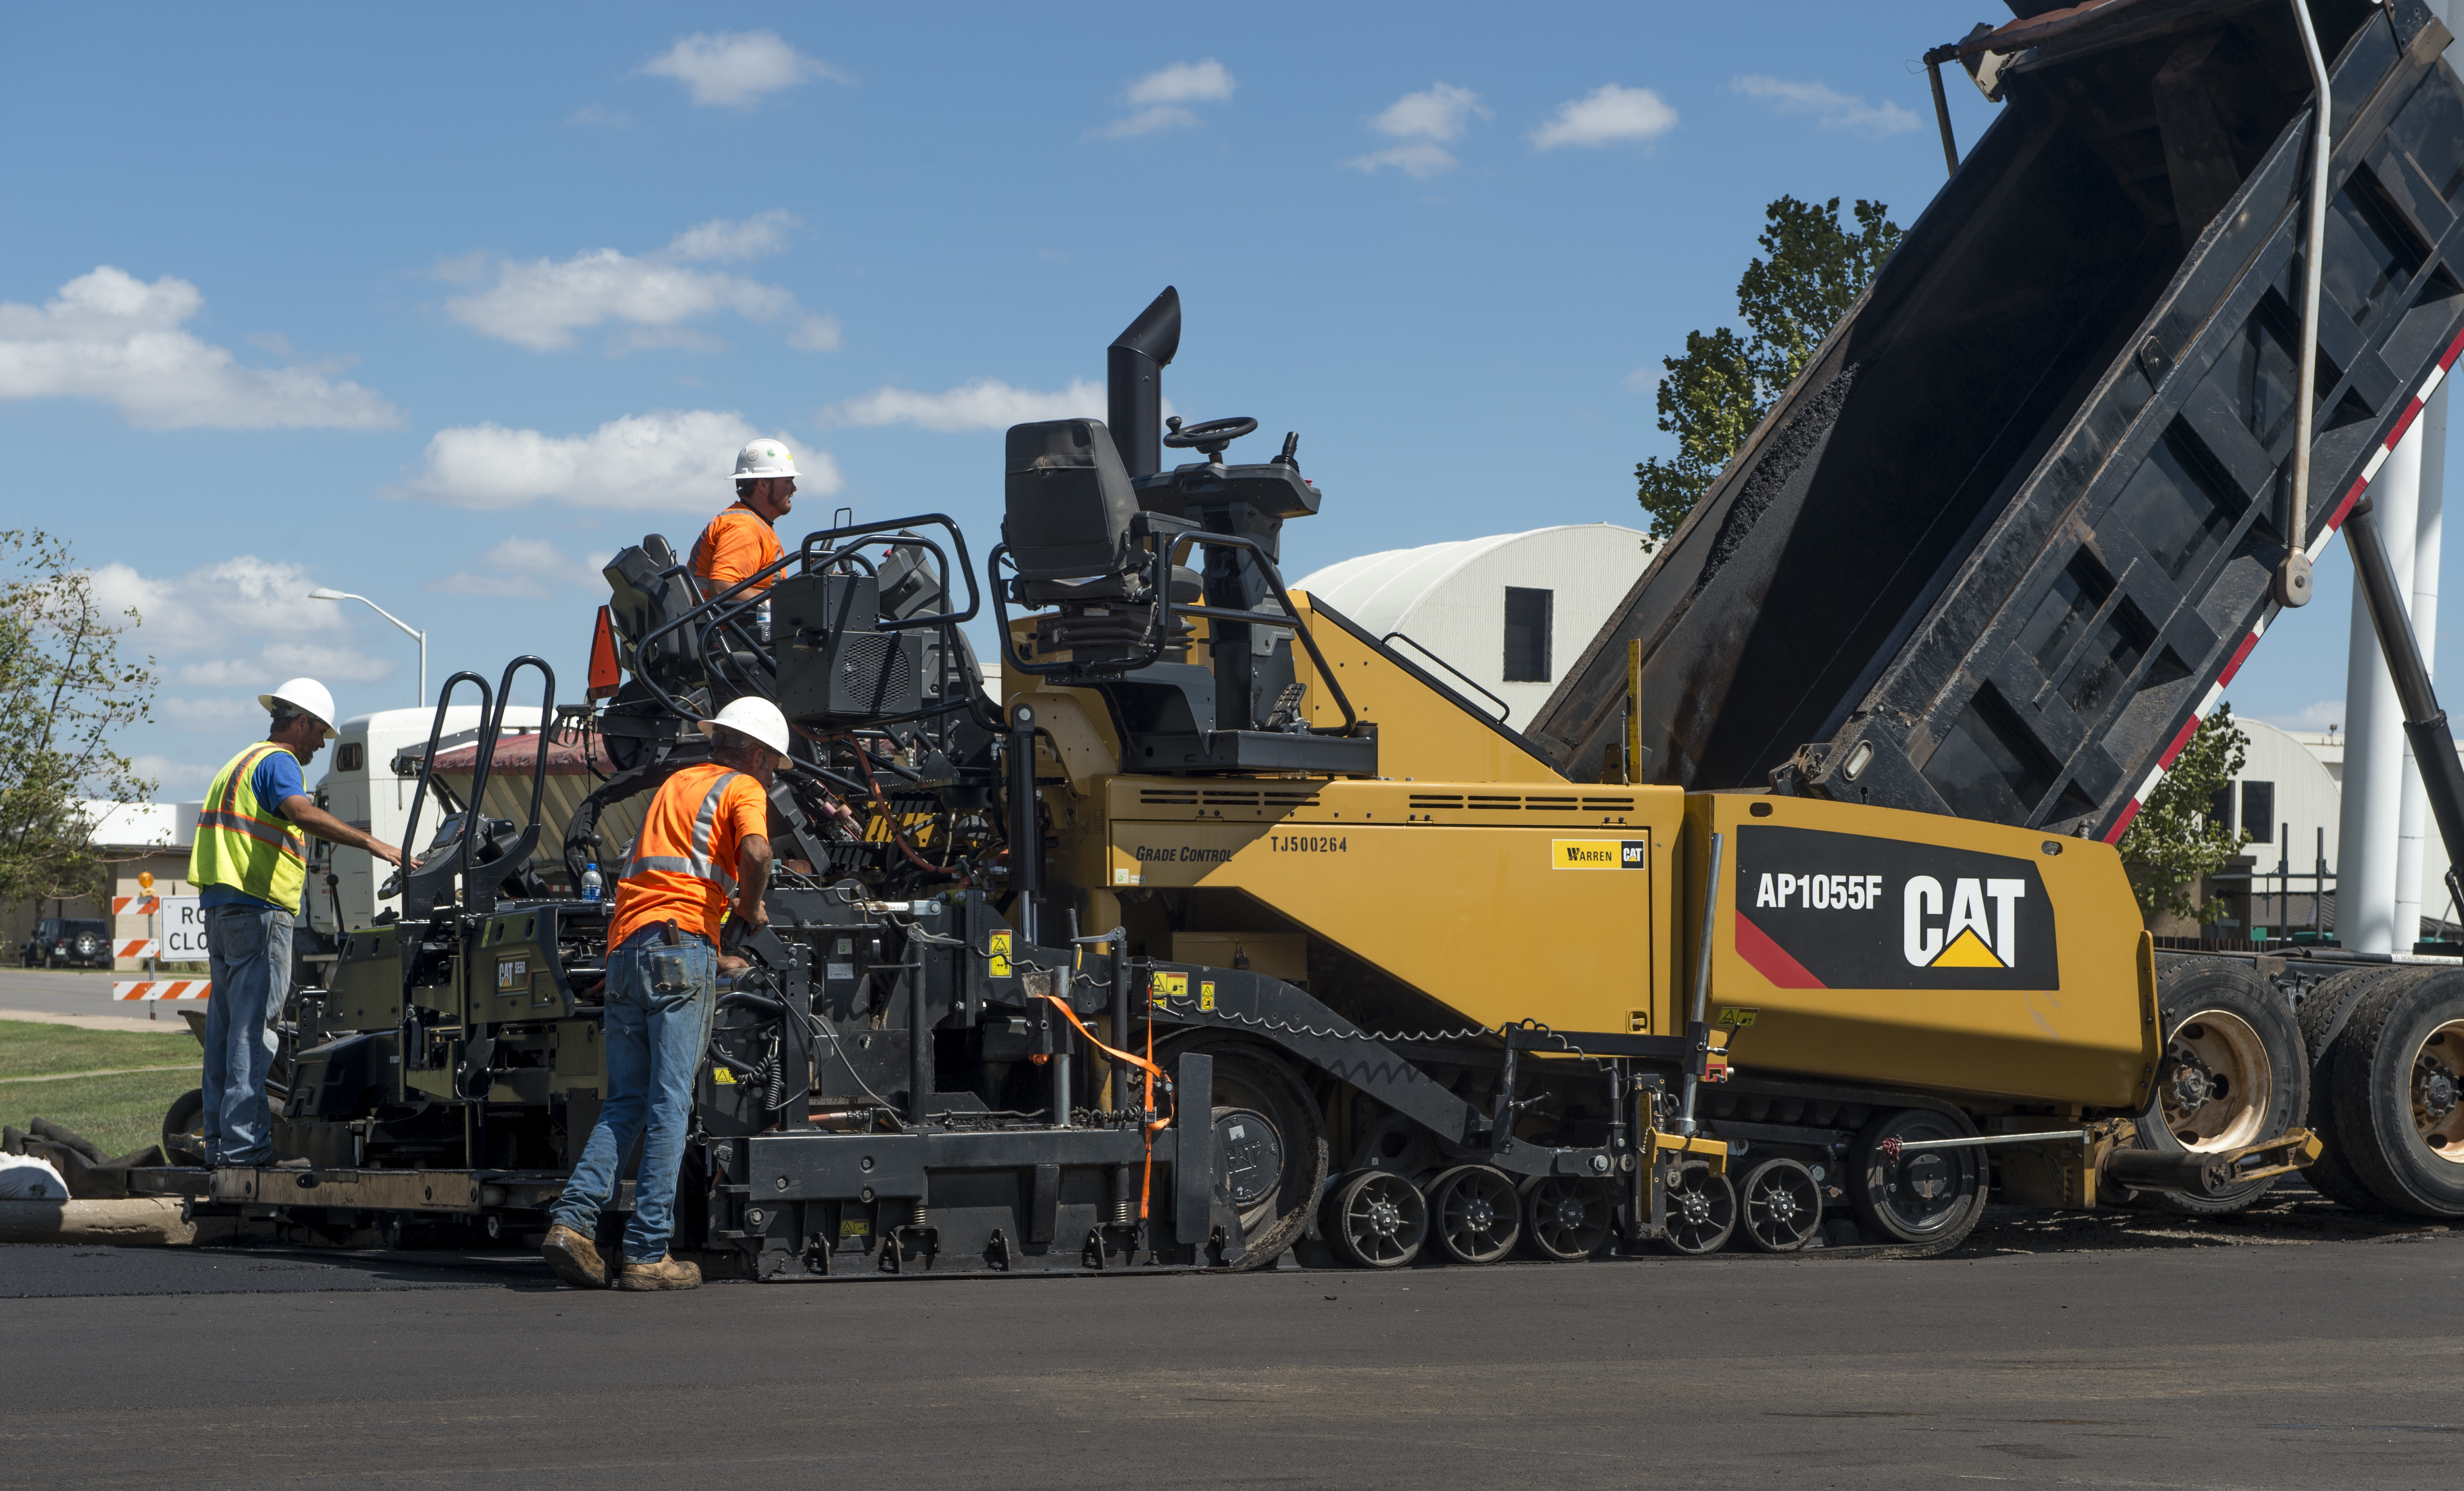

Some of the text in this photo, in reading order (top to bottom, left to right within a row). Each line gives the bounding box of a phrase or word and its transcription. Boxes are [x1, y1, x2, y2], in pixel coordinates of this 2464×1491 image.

[1271, 836, 1347, 852] TJ500264
[1135, 845, 1233, 862] GRADE CONTROL
[1566, 847, 1642, 862] WARREN CAT
[1756, 873, 1882, 910] AP1055F
[182, 907, 206, 924] RO
[1903, 875, 2025, 968] CAT
[169, 932, 208, 950] CLO
[499, 962, 513, 987] CAT
[515, 961, 526, 974] SE60
